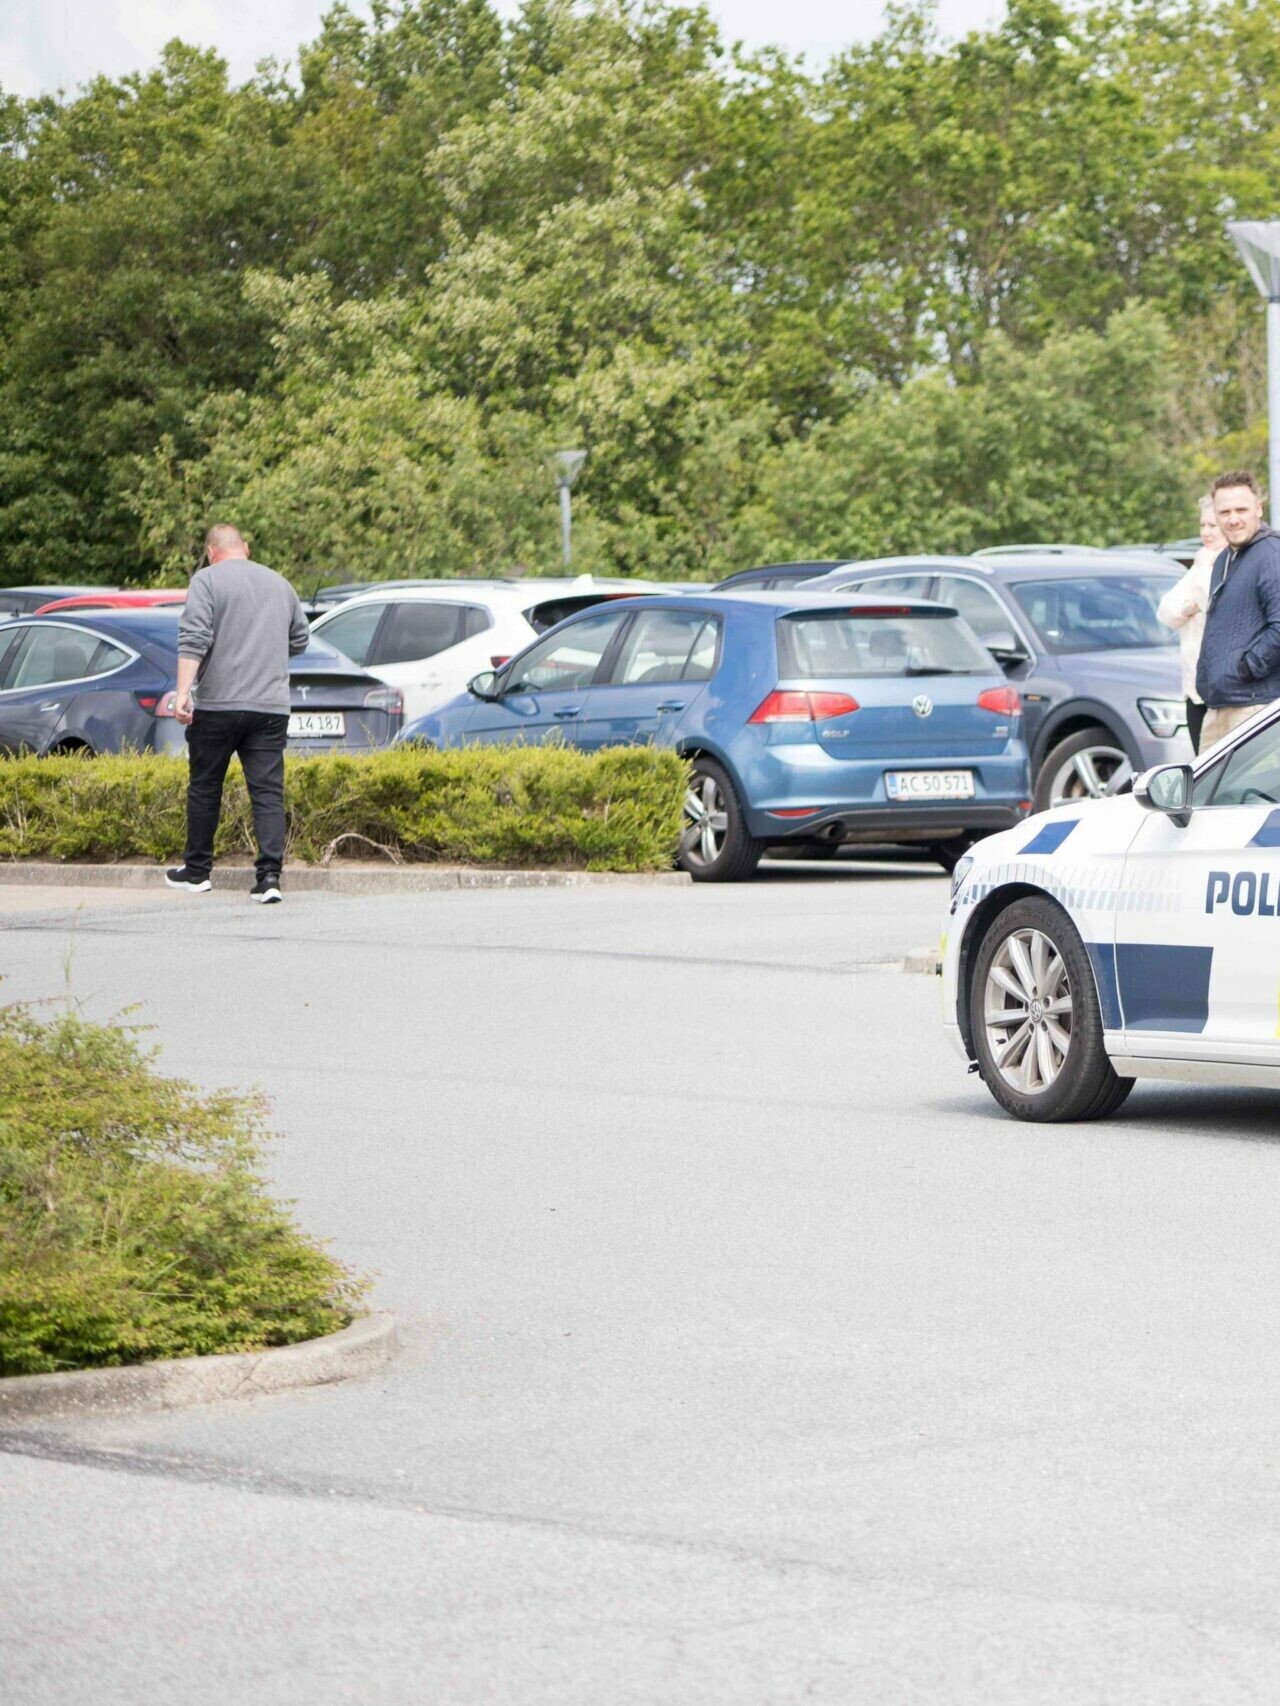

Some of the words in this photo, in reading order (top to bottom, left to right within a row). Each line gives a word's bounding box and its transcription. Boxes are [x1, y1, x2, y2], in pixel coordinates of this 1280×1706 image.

[297, 716, 313, 730] 14
[318, 715, 341, 731] 187
[900, 776, 920, 792] AC
[923, 775, 940, 791] 50
[944, 775, 968, 791] 571
